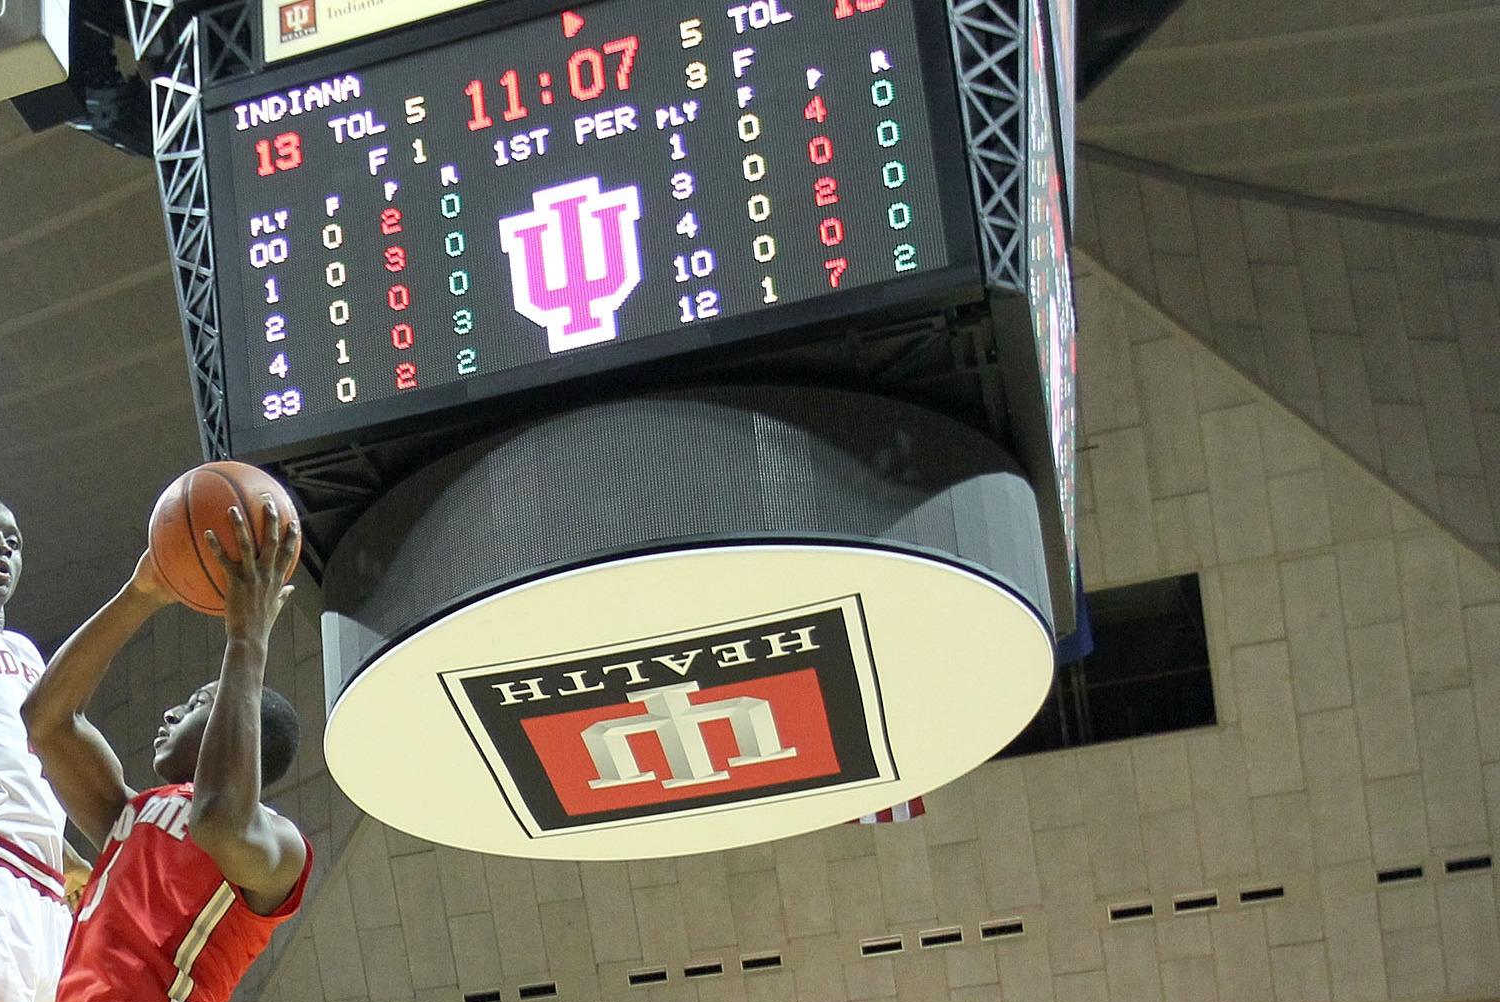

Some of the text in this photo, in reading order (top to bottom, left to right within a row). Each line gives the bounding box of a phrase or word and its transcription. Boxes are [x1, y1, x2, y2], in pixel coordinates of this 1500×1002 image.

[680, 19, 702, 48] 5
[727, 0, 795, 33] TOL
[235, 74, 363, 130] INDIANA
[463, 36, 640, 132] 11:07
[656, 100, 700, 129] PLY
[868, 50, 893, 73] R
[686, 46, 756, 89] 3 F
[255, 132, 303, 176] 13
[328, 96, 426, 143] TOL 5
[494, 104, 640, 166] 1ST PER
[670, 79, 894, 160] 1 0 4 0
[367, 139, 427, 175] F 1
[671, 120, 900, 200] 3 0 0 0
[249, 193, 461, 268] 00 0 2 0
[250, 208, 289, 236] PLY
[326, 194, 342, 216] F
[440, 163, 460, 186] R
[677, 161, 906, 238] 4 0 2 0
[265, 231, 464, 303] 1 0 3 0
[673, 202, 911, 282] 10 0 0 0
[264, 270, 468, 344] 2 0 0 0
[679, 244, 917, 323] 12 1 7 2
[267, 307, 473, 379] 4 1 0 3
[261, 347, 477, 420] 33 0 2 2
[491, 626, 821, 706] HEALTH
